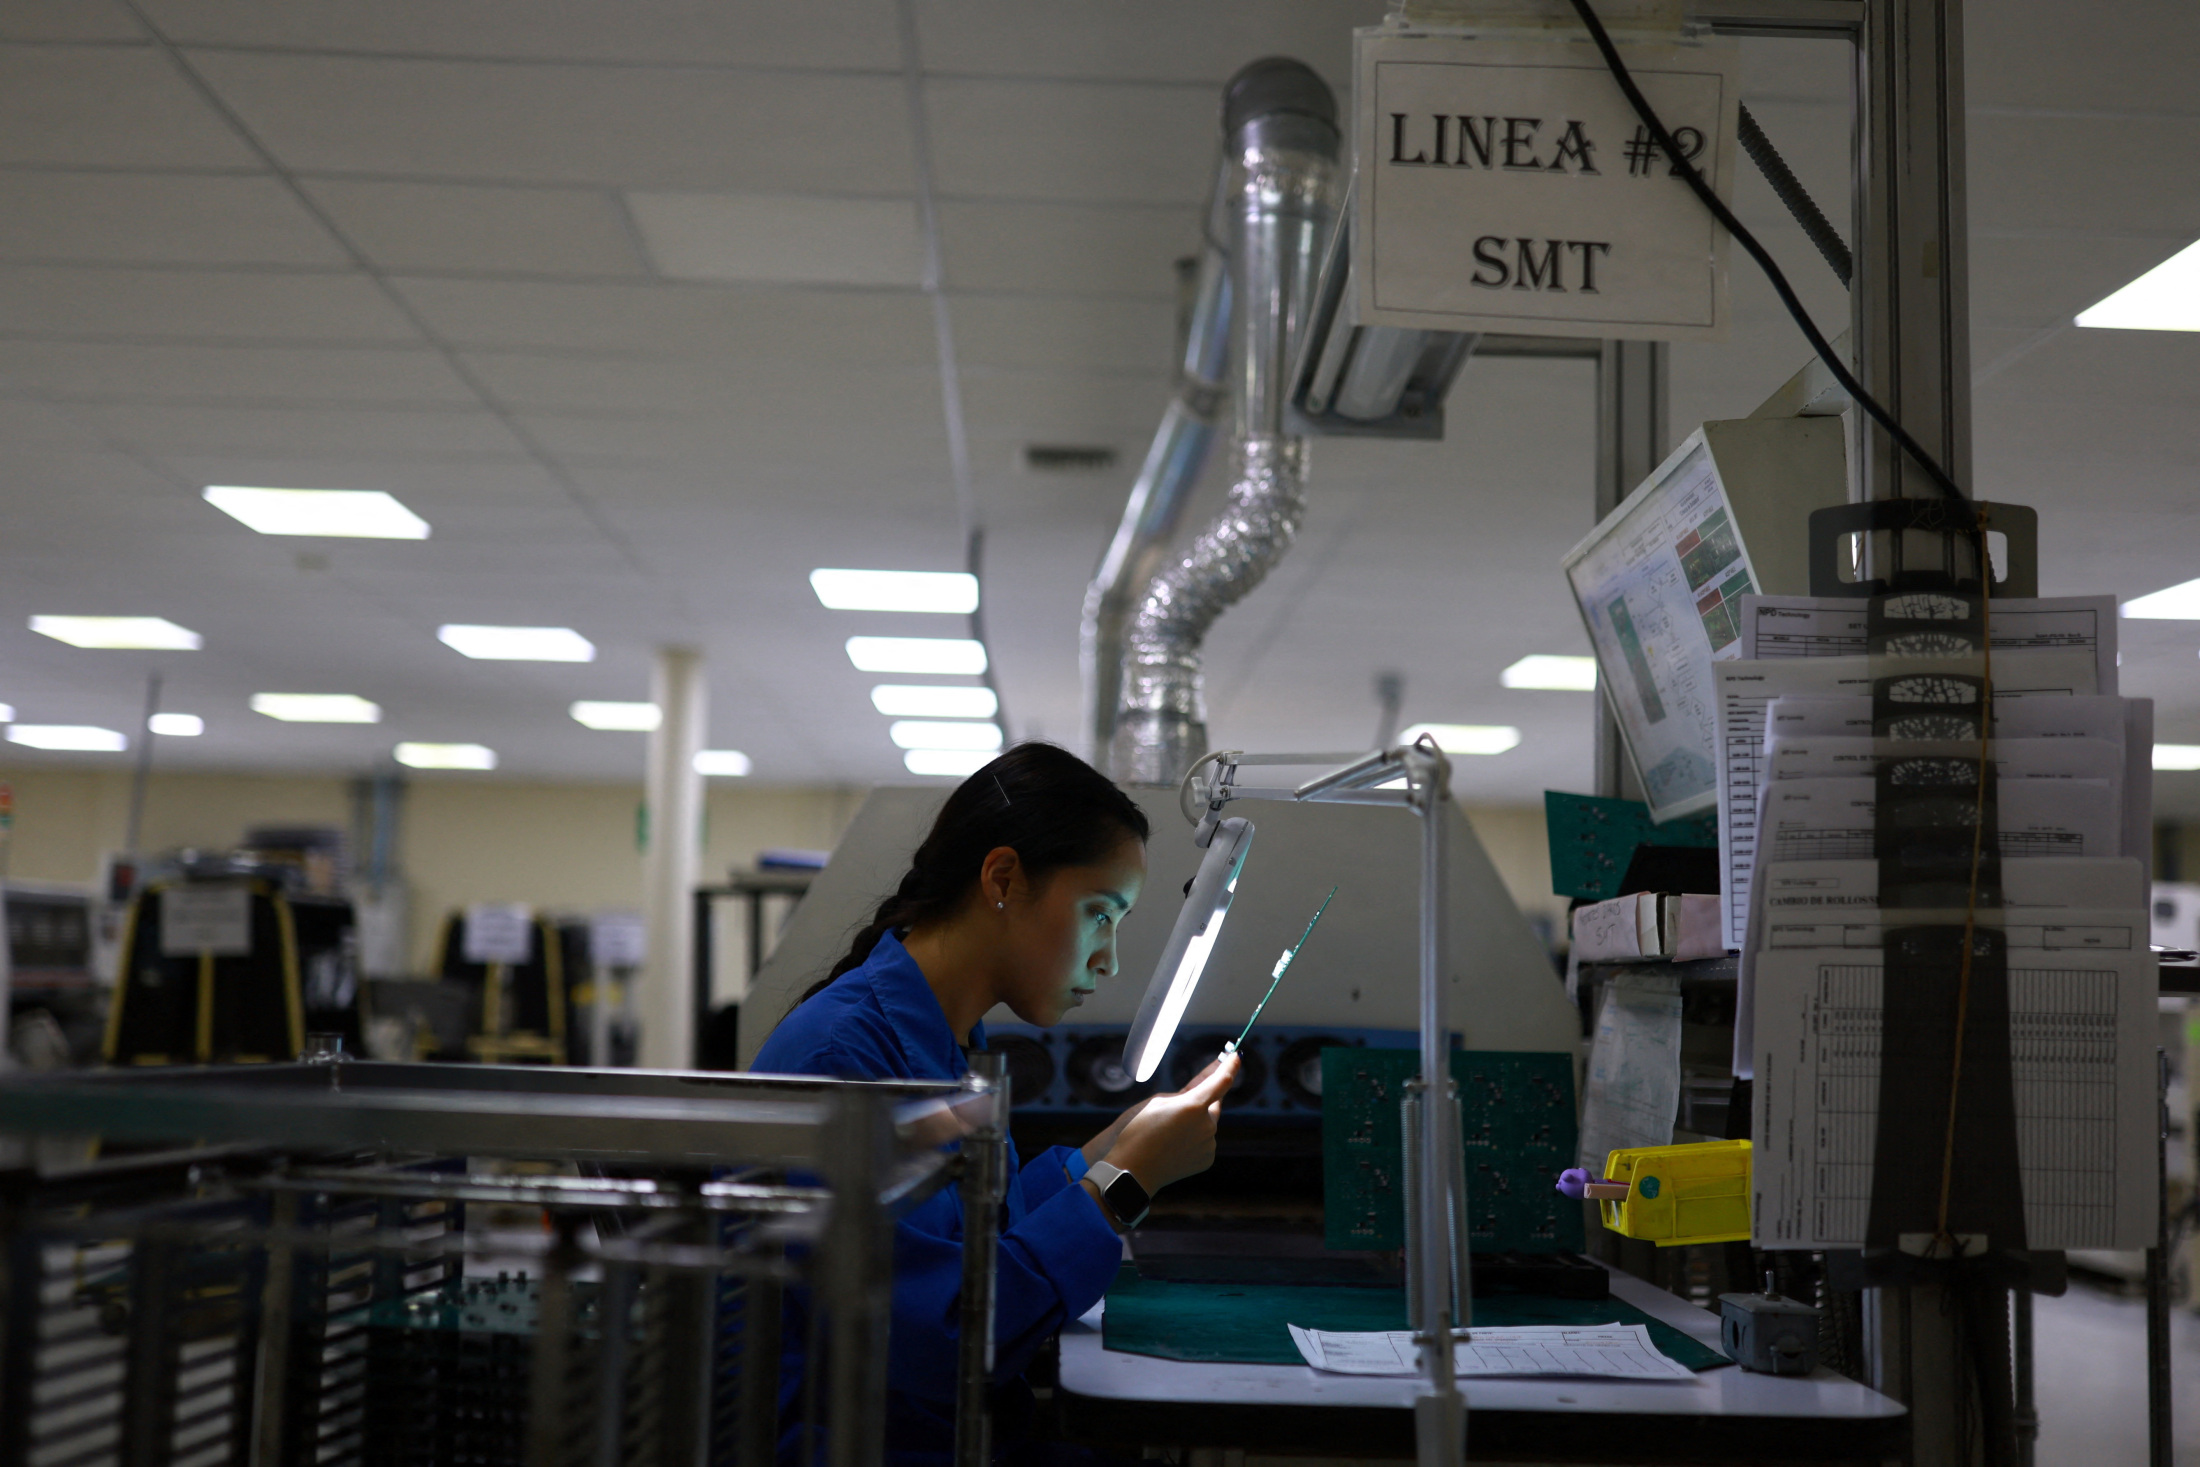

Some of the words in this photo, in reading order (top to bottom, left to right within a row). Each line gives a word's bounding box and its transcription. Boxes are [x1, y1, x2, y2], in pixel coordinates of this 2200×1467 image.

[1389, 113, 1602, 176] LINEA
[1623, 124, 1707, 181] #2
[1470, 235, 1612, 294] SMT
[1759, 608, 1777, 617] NPD
[1778, 611, 1810, 619] Technology
[1810, 896, 1823, 905] DE
